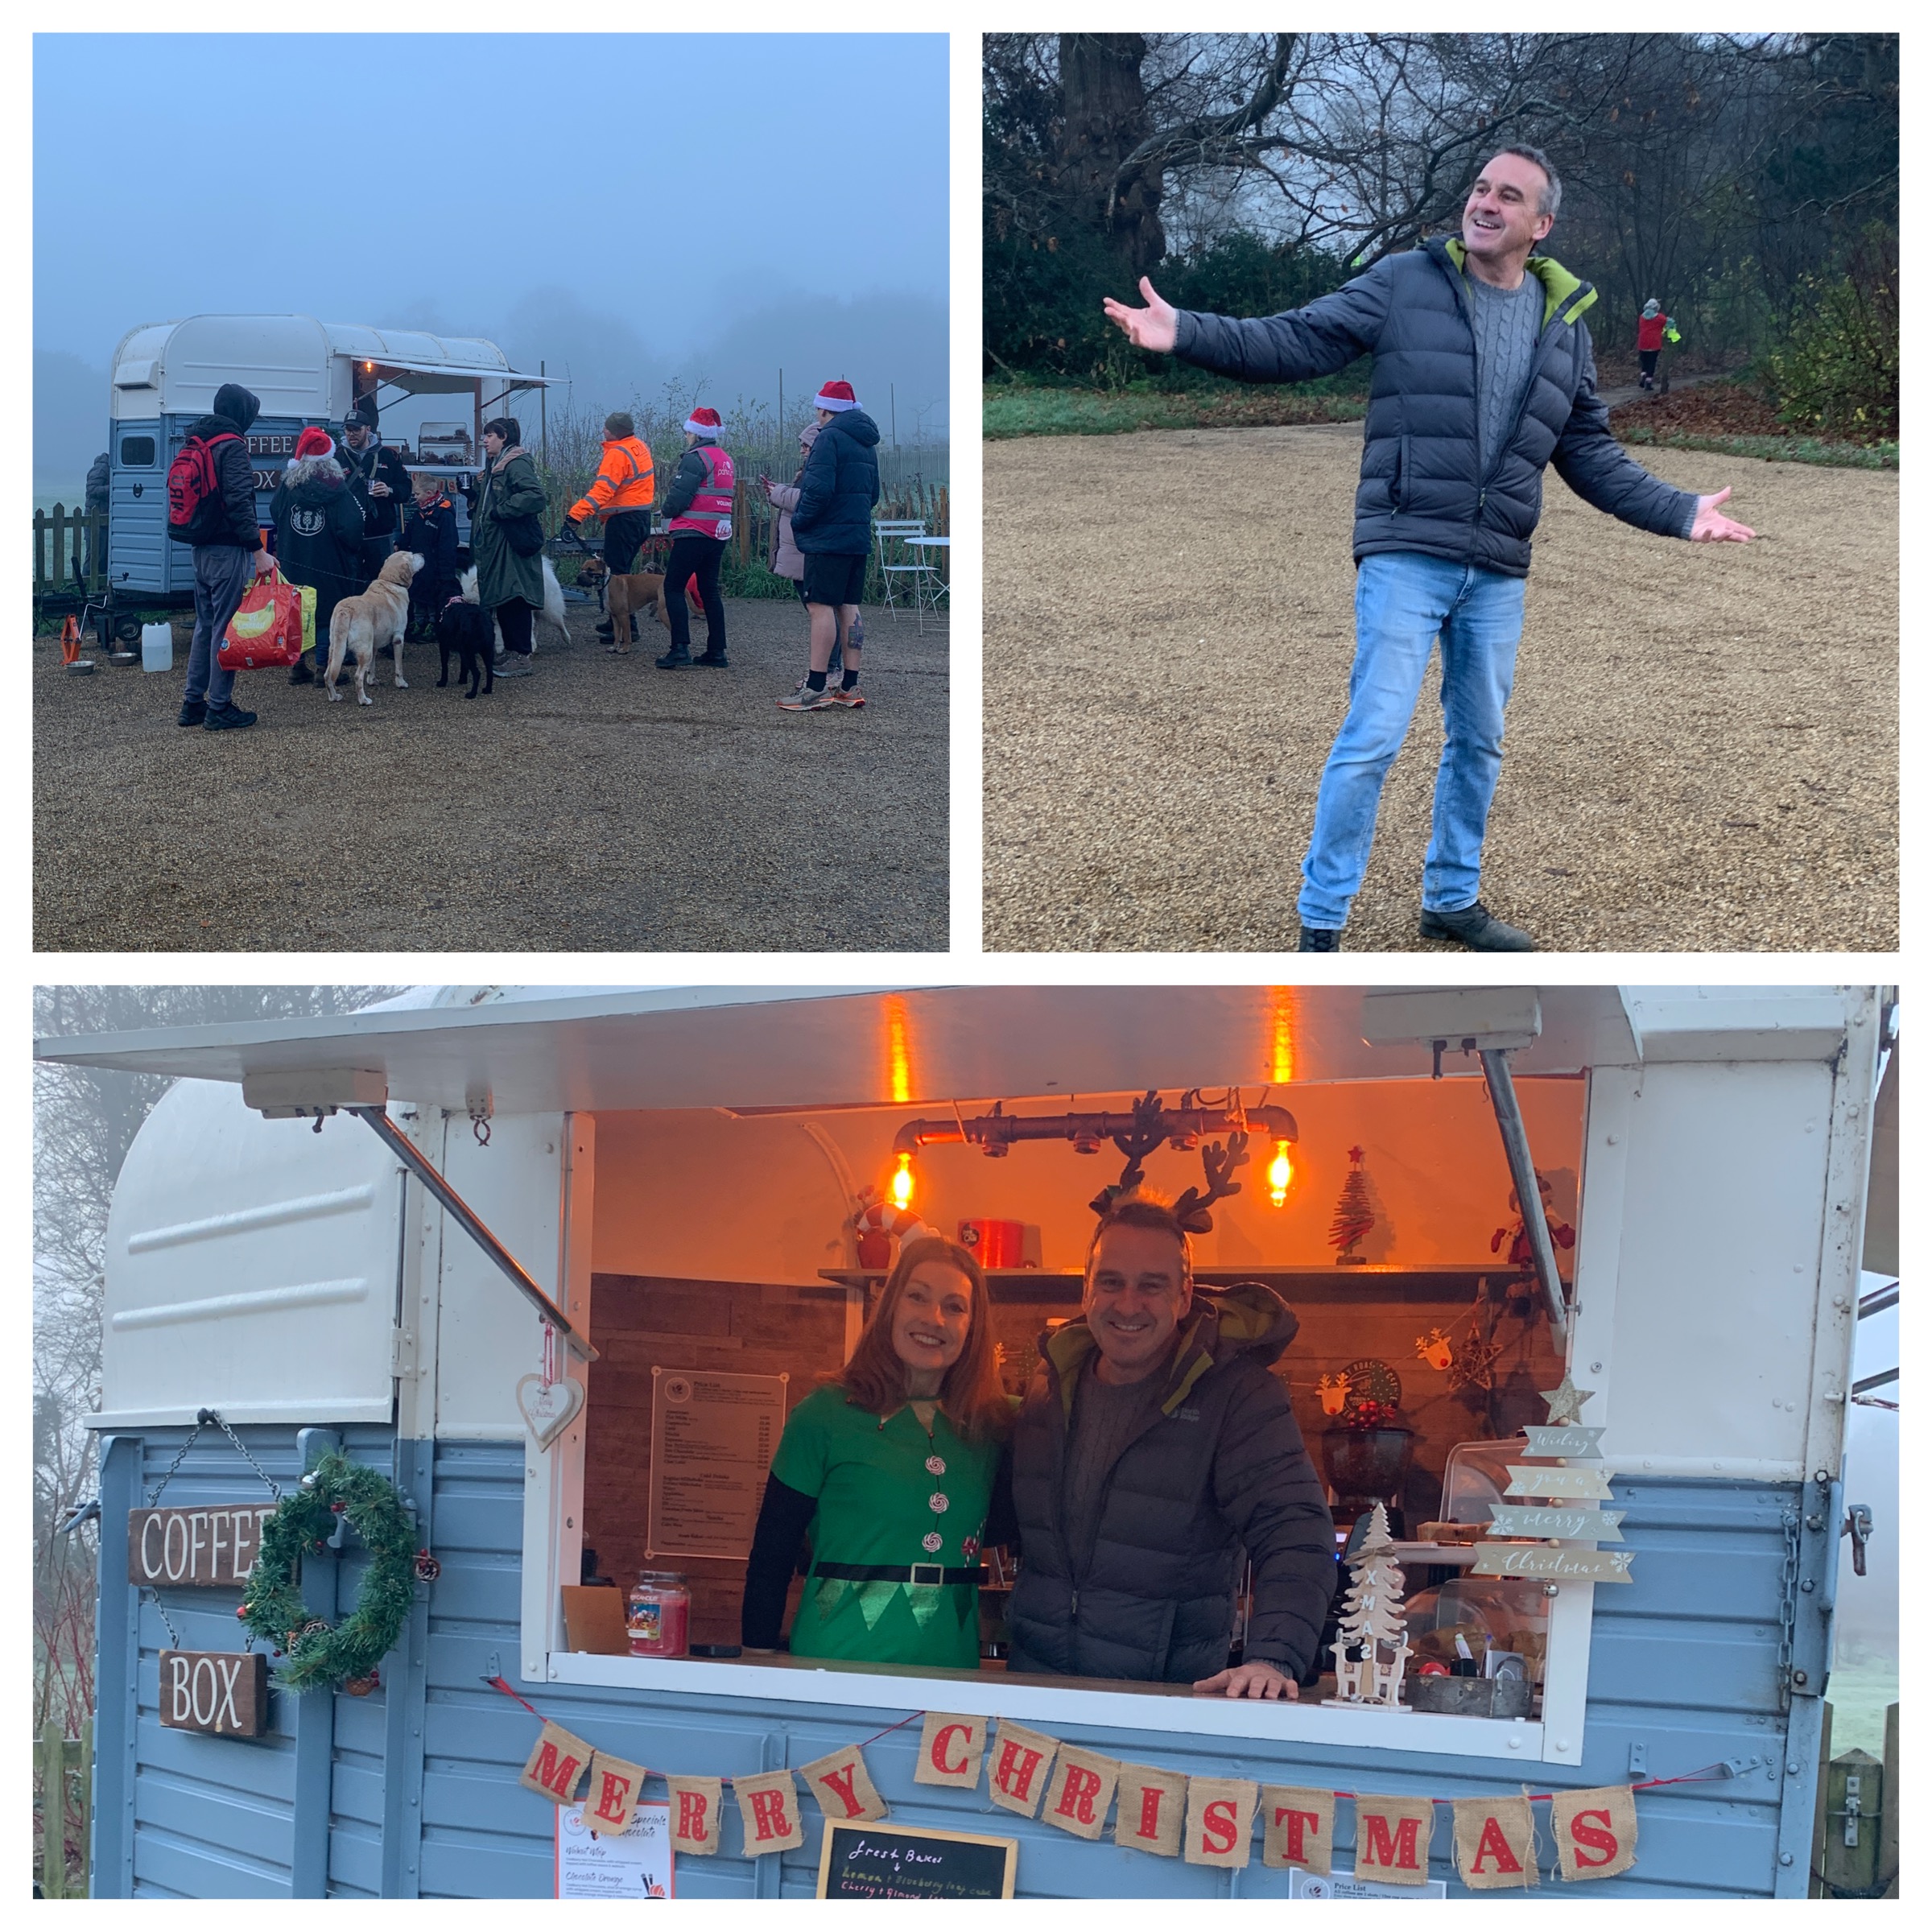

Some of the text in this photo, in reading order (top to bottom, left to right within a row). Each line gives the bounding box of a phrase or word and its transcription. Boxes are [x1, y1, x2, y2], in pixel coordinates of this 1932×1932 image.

[245, 436, 293, 453] FFEE
[253, 470, 276, 489] OX
[1537, 1430, 1591, 1455] Wishing
[1530, 1472, 1567, 1492] you
[1501, 1550, 1604, 1575] Christmas
[170, 1657, 242, 1728] BOX
[529, 1724, 1619, 1874] MERRY CHRISTMAS
[630, 1813, 667, 1828] Specials
[618, 1826, 655, 1839] hocolate
[1334, 1882, 1352, 1890] Price
[1352, 1884, 1366, 1892] List
